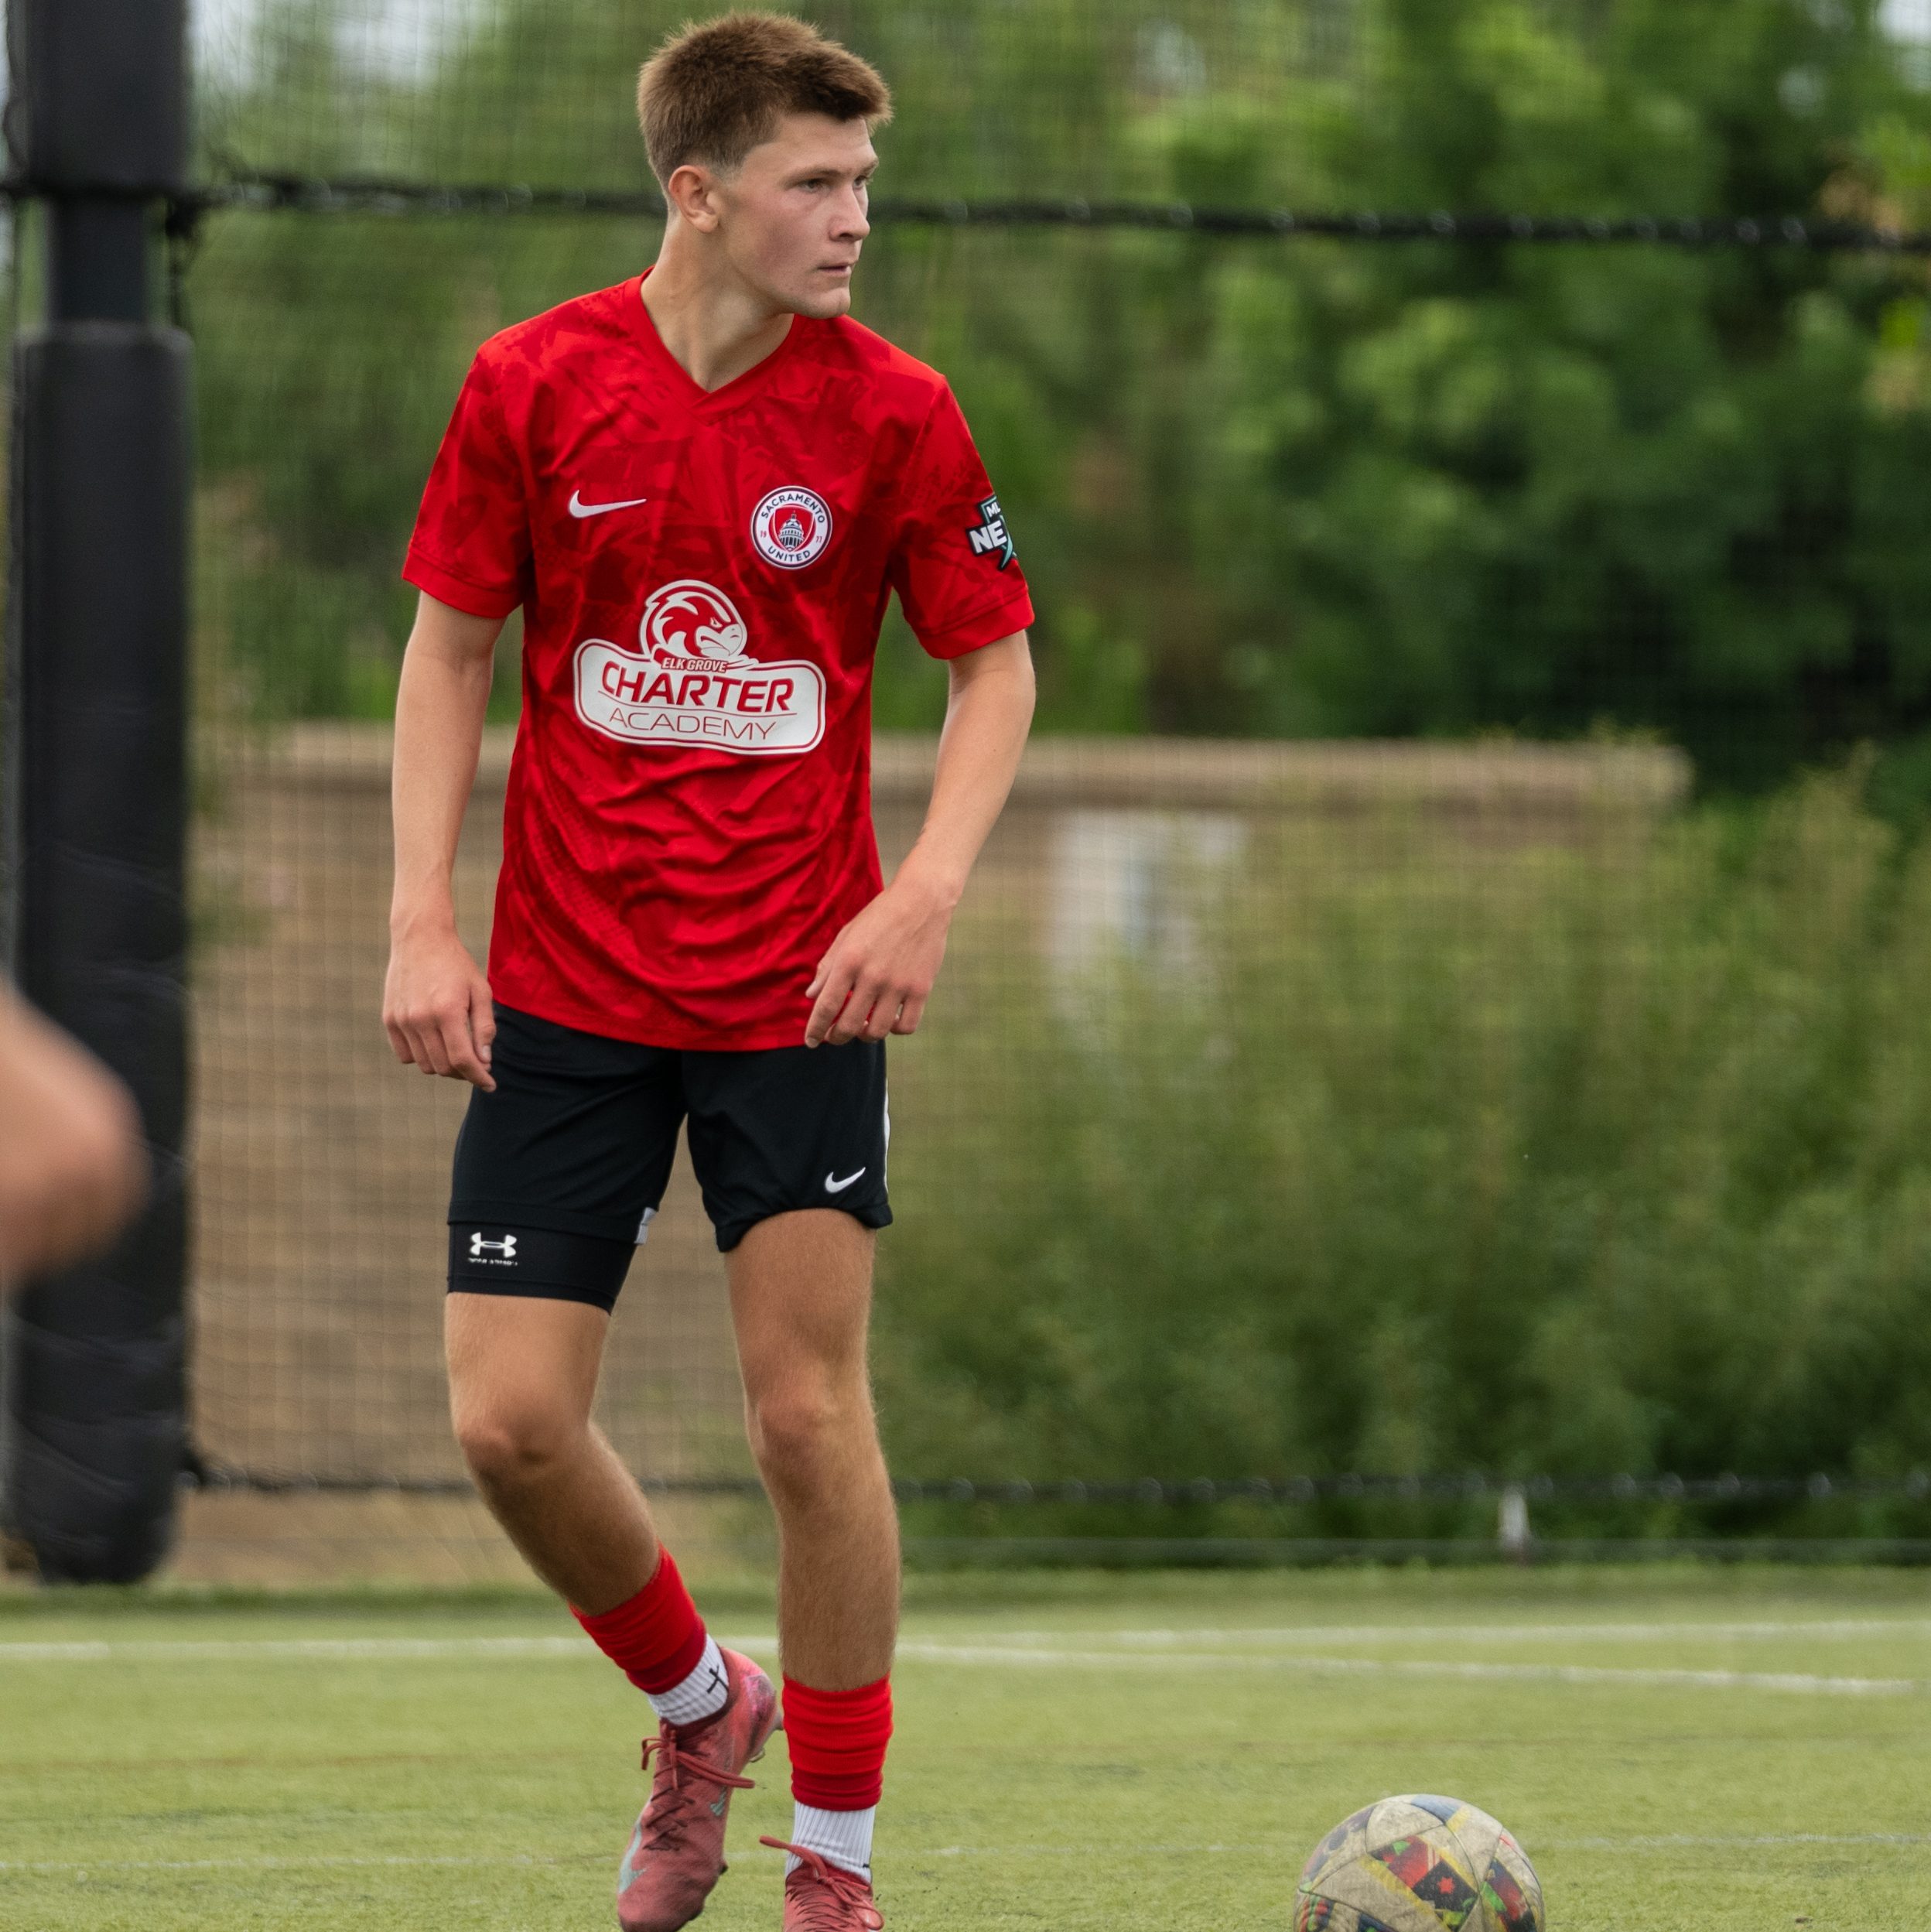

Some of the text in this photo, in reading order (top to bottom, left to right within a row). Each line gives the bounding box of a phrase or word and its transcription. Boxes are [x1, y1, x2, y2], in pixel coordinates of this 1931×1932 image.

[761, 494, 825, 523] SACRAMENTO
[986, 501, 1001, 518] ML
[767, 545, 811, 562] UNITED
[661, 657, 728, 672] ELK GROVE
[602, 661, 795, 713] CHARTER
[609, 707, 776, 740] ACADEMY
